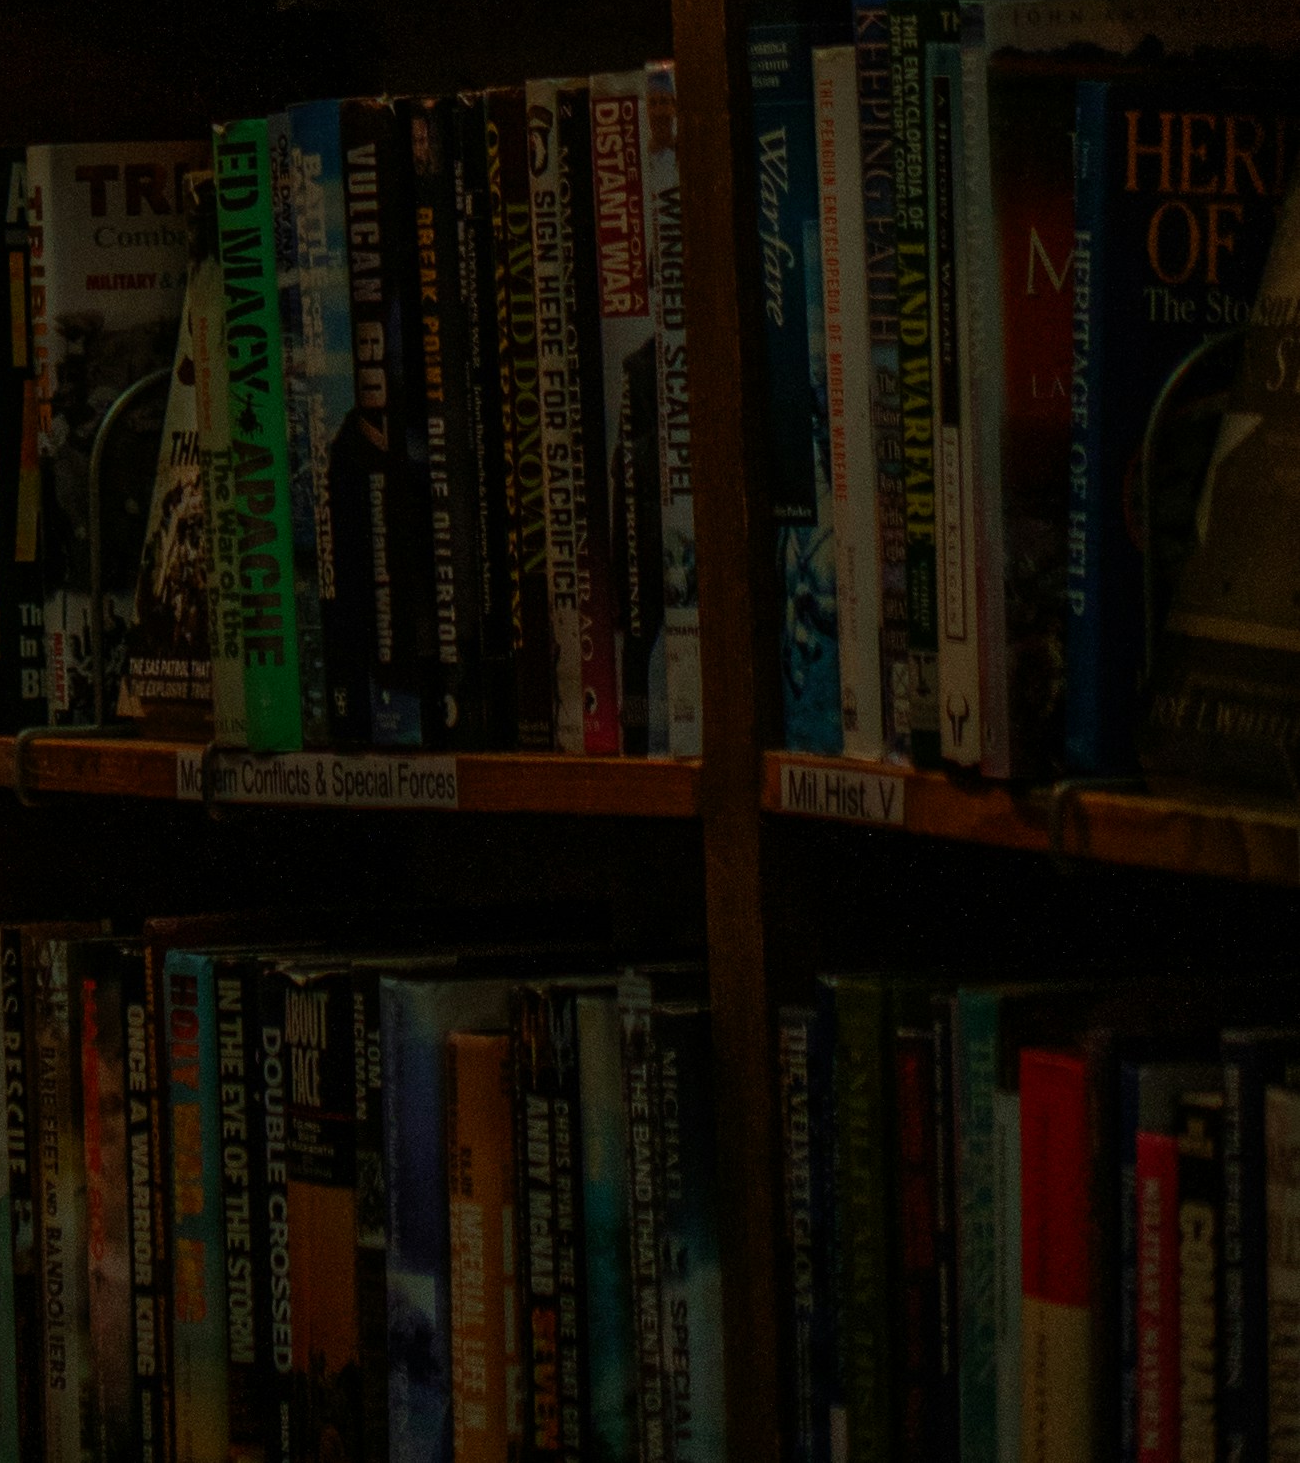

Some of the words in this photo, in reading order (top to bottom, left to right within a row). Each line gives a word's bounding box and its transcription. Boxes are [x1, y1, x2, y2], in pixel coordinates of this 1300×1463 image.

[902, 14, 918, 48] THE
[619, 98, 640, 183] ONCE
[820, 116, 838, 187] PENGUIN
[903, 55, 923, 188] ENCYCLOPEDIA
[215, 140, 259, 213] ED
[593, 100, 629, 234] DISTANT
[347, 141, 384, 303] VULCAN
[534, 189, 559, 263] SIGN
[625, 194, 643, 280] UPON
[757, 125, 796, 328] Warfare
[907, 195, 925, 230] OF
[1145, 198, 1244, 286] OF
[86, 272, 157, 291] MILITARY
[416, 205, 439, 303] BREAK
[505, 202, 539, 347] DAVID
[601, 241, 633, 316] WAR
[656, 186, 686, 331] WINGED
[823, 194, 841, 314] ENCYCLOPEDIA
[898, 241, 929, 347] LAND
[219, 225, 271, 395] MACY
[538, 275, 564, 358] HERE
[630, 293, 646, 312] A
[1070, 230, 1093, 429] HERITAGE
[354, 320, 390, 453] 607
[421, 314, 446, 404] POINT
[543, 369, 567, 431] FOR
[663, 342, 693, 498] SCALPEL
[213, 446, 232, 502] The
[512, 356, 549, 575] DONOVAN
[831, 426, 849, 502] WARFARE
[901, 357, 936, 546] WARFARE
[1069, 442, 1089, 501] OF
[216, 513, 236, 566] War
[231, 438, 286, 670] APACHE
[368, 471, 390, 588] Rowland
[546, 442, 579, 612] SACRIFICE
[223, 608, 241, 660] the
[374, 586, 395, 664] White
[180, 759, 237, 794] Moern
[240, 760, 311, 797] Conflicts
[315, 761, 327, 797] &
[331, 762, 394, 802] Special
[398, 763, 456, 800] Forces
[877, 778, 896, 821] V
[1, 945, 18, 1014] SAS
[217, 978, 243, 1012] IN
[284, 985, 330, 1050] ABOUT
[40, 1044, 56, 1109] BARE
[126, 1003, 146, 1094] ONCE
[219, 1018, 245, 1078] THE
[291, 1047, 322, 1108] FACE
[352, 991, 368, 1122] HICKMAN
[365, 1028, 382, 1090] TOM
[3, 1031, 28, 1176] RESCUE
[129, 1097, 149, 1125] A
[221, 1082, 248, 1140] EYE
[261, 1025, 286, 1184] DOUBLE
[629, 1062, 649, 1122] THE
[659, 1048, 682, 1202] MICHAEL
[42, 1113, 58, 1176] FEET
[223, 1144, 249, 1184] OF
[526, 1092, 551, 1186] ANDY
[631, 1125, 653, 1204] BAND
[44, 1181, 58, 1219] AND
[129, 1132, 154, 1288] WARRIOR
[225, 1188, 252, 1248] THE
[267, 1194, 293, 1374] CROSSED
[635, 1211, 656, 1282] THAT
[46, 1227, 66, 1392] BANDOLIERS
[133, 1294, 157, 1378] KING
[227, 1252, 256, 1364] STORM
[638, 1287, 659, 1362] WENT
[642, 1367, 662, 1413] TO
[670, 1297, 691, 1442] SPECIAL
